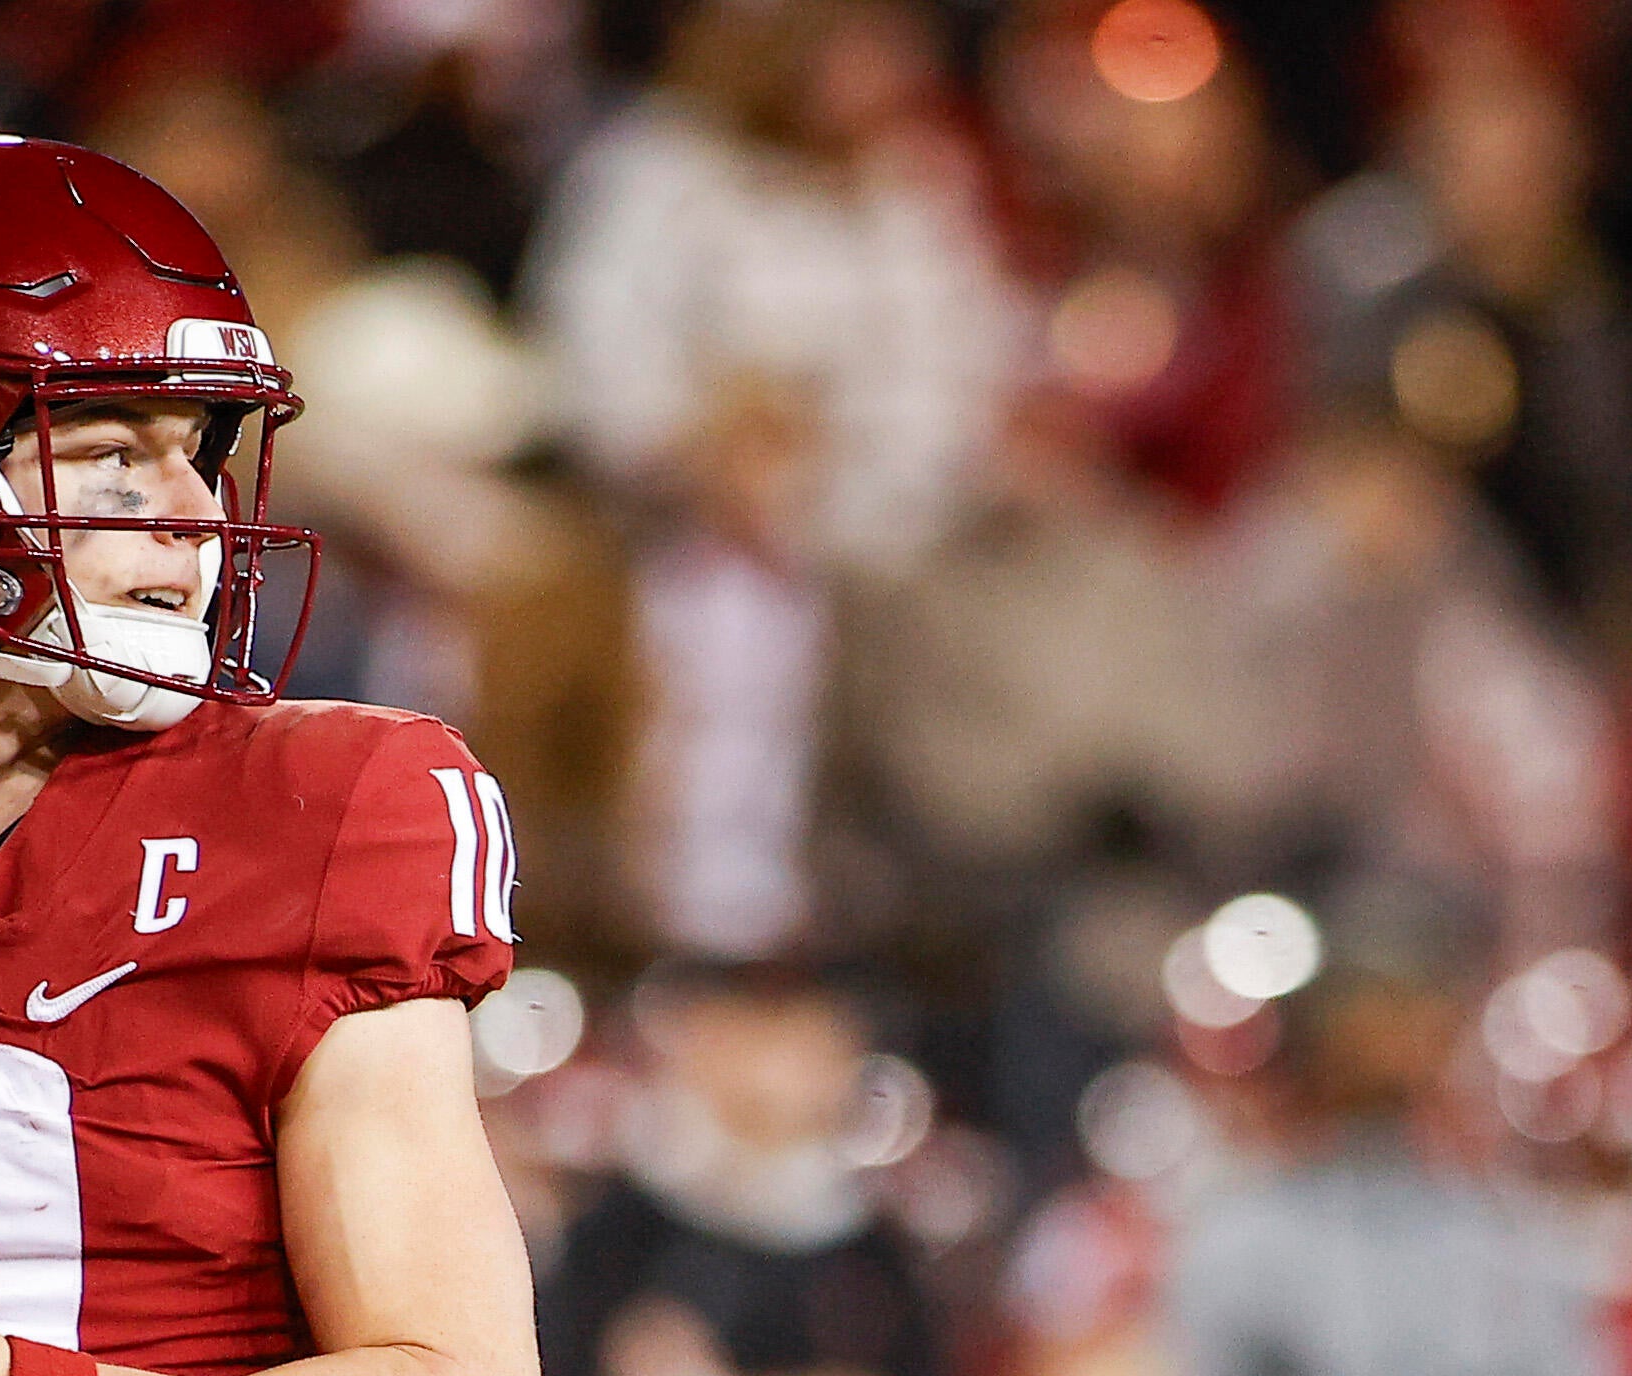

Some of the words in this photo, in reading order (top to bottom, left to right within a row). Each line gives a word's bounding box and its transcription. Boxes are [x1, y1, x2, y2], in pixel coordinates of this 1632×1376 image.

[217, 326, 258, 359] WSU
[133, 836, 200, 935] C
[428, 766, 518, 944] 10
